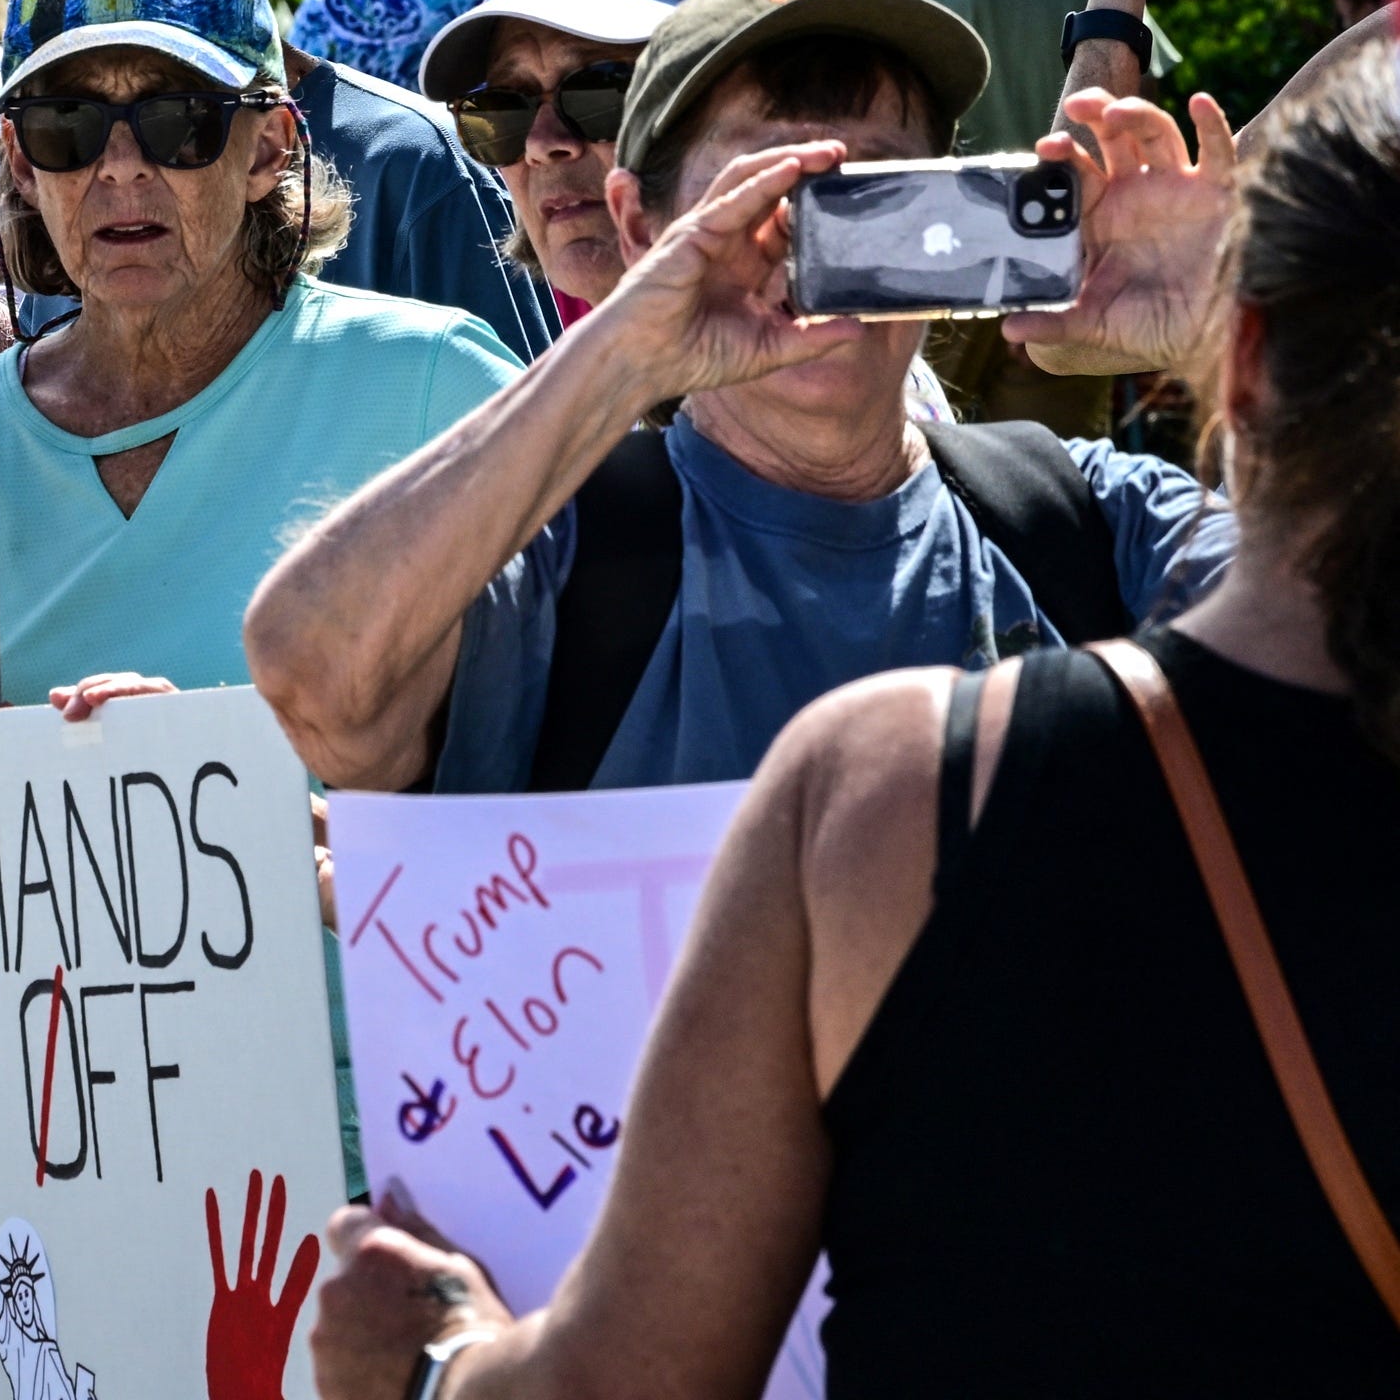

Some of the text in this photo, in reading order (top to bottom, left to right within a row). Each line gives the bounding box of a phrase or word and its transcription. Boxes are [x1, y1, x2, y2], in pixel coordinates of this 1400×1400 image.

[350, 831, 551, 1004] Trump
[18, 972, 196, 1184] OFF
[452, 946, 604, 1100] Elon
